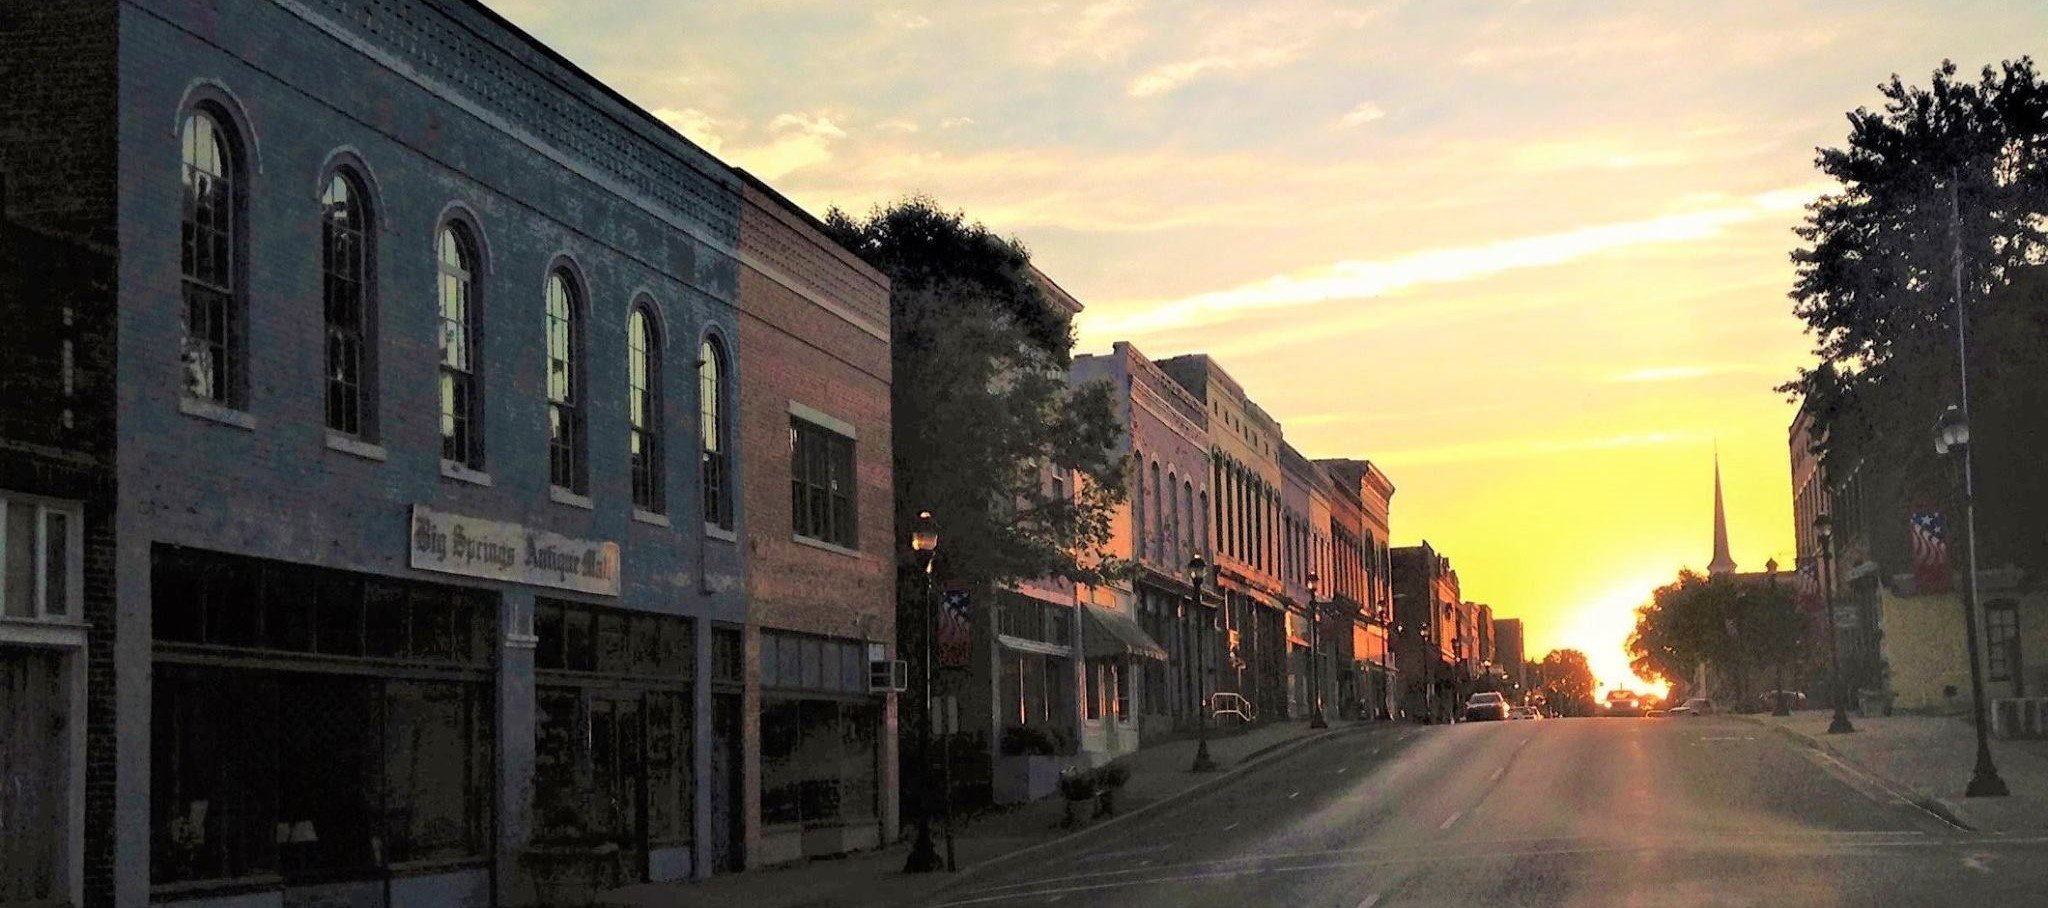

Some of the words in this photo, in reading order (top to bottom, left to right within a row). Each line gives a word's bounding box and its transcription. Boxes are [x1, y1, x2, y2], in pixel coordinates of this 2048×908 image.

[414, 515, 446, 562] Big
[453, 523, 516, 571] Springs
[524, 532, 580, 583] Antique
